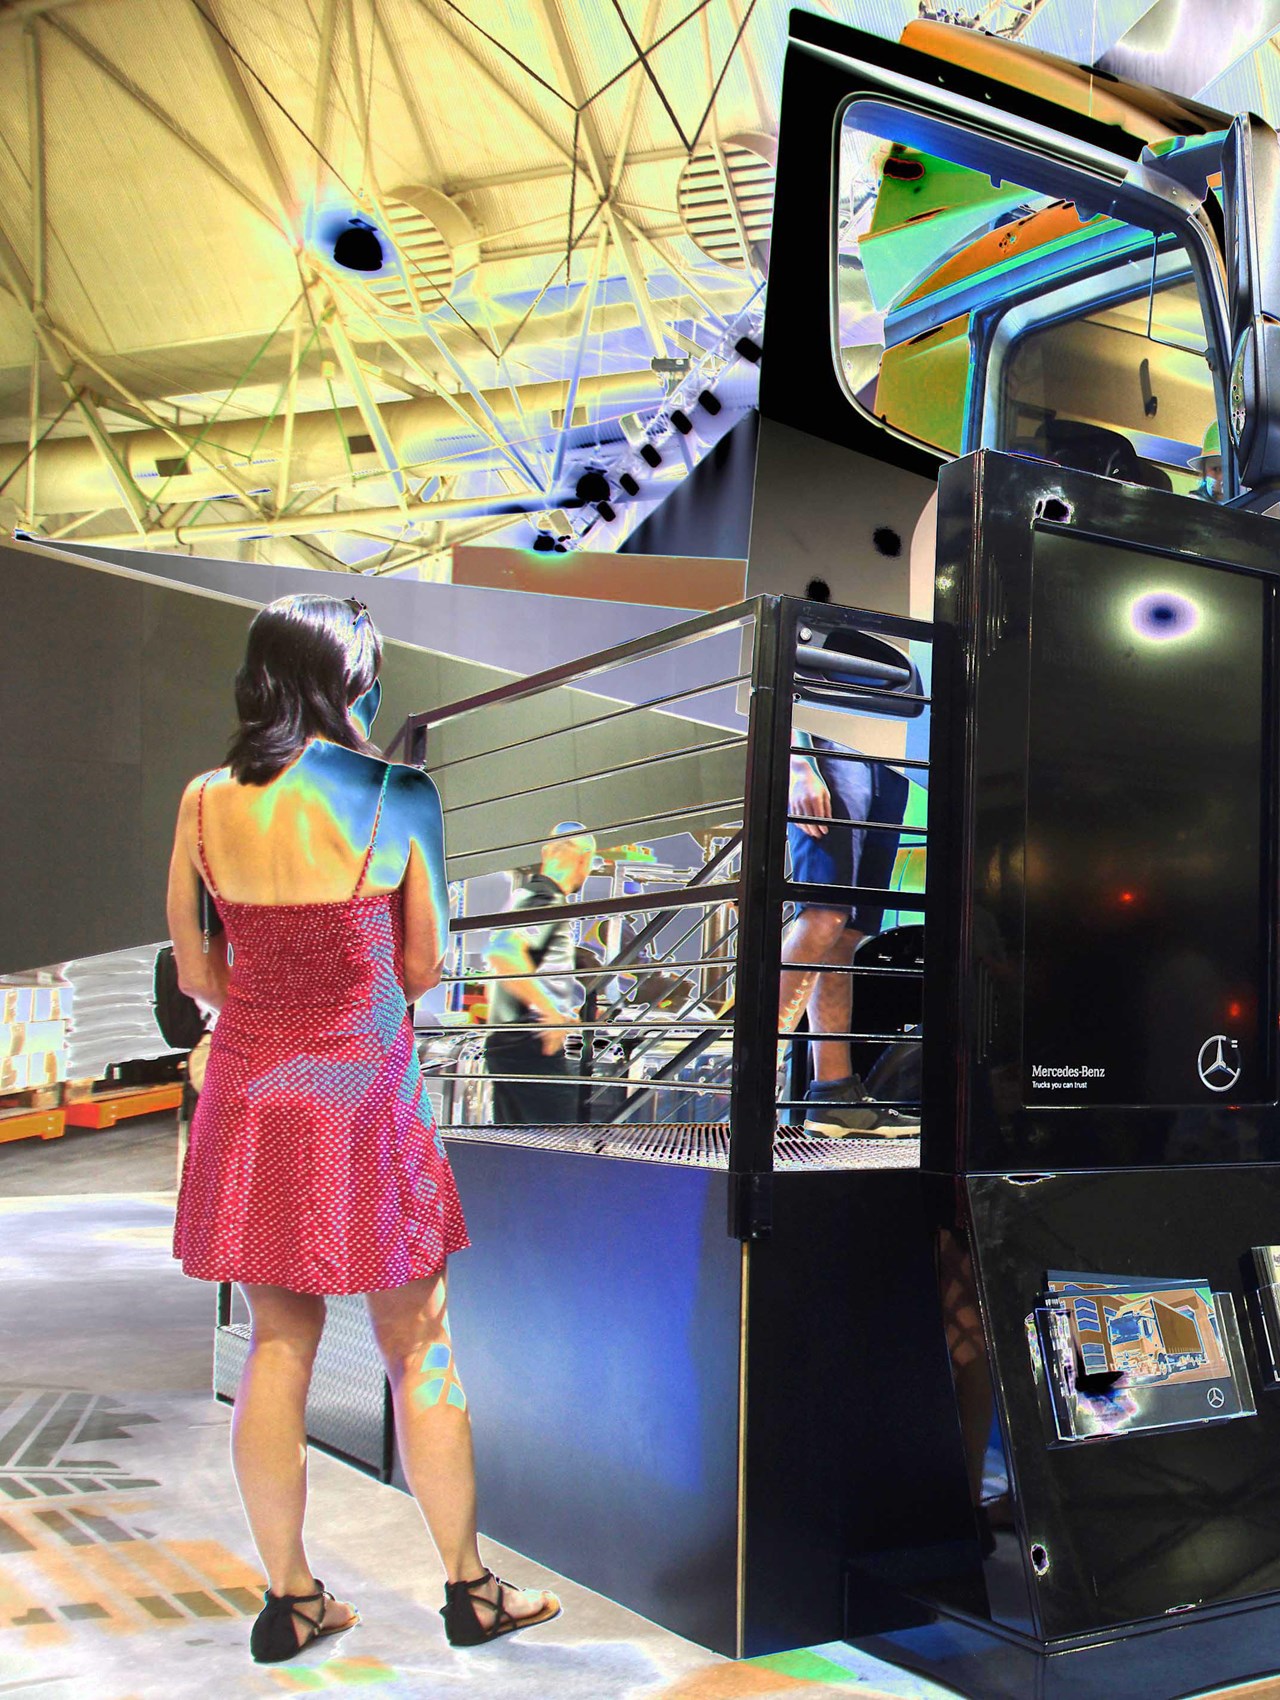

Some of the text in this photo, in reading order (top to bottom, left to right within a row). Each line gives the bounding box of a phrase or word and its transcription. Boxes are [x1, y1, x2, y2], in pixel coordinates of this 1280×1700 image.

[1031, 1065, 1105, 1077] Mercedes-Benz
[1032, 1080, 1050, 1089] Trucks
[1051, 1082, 1062, 1090] you
[1074, 1081, 1088, 1089] trust
